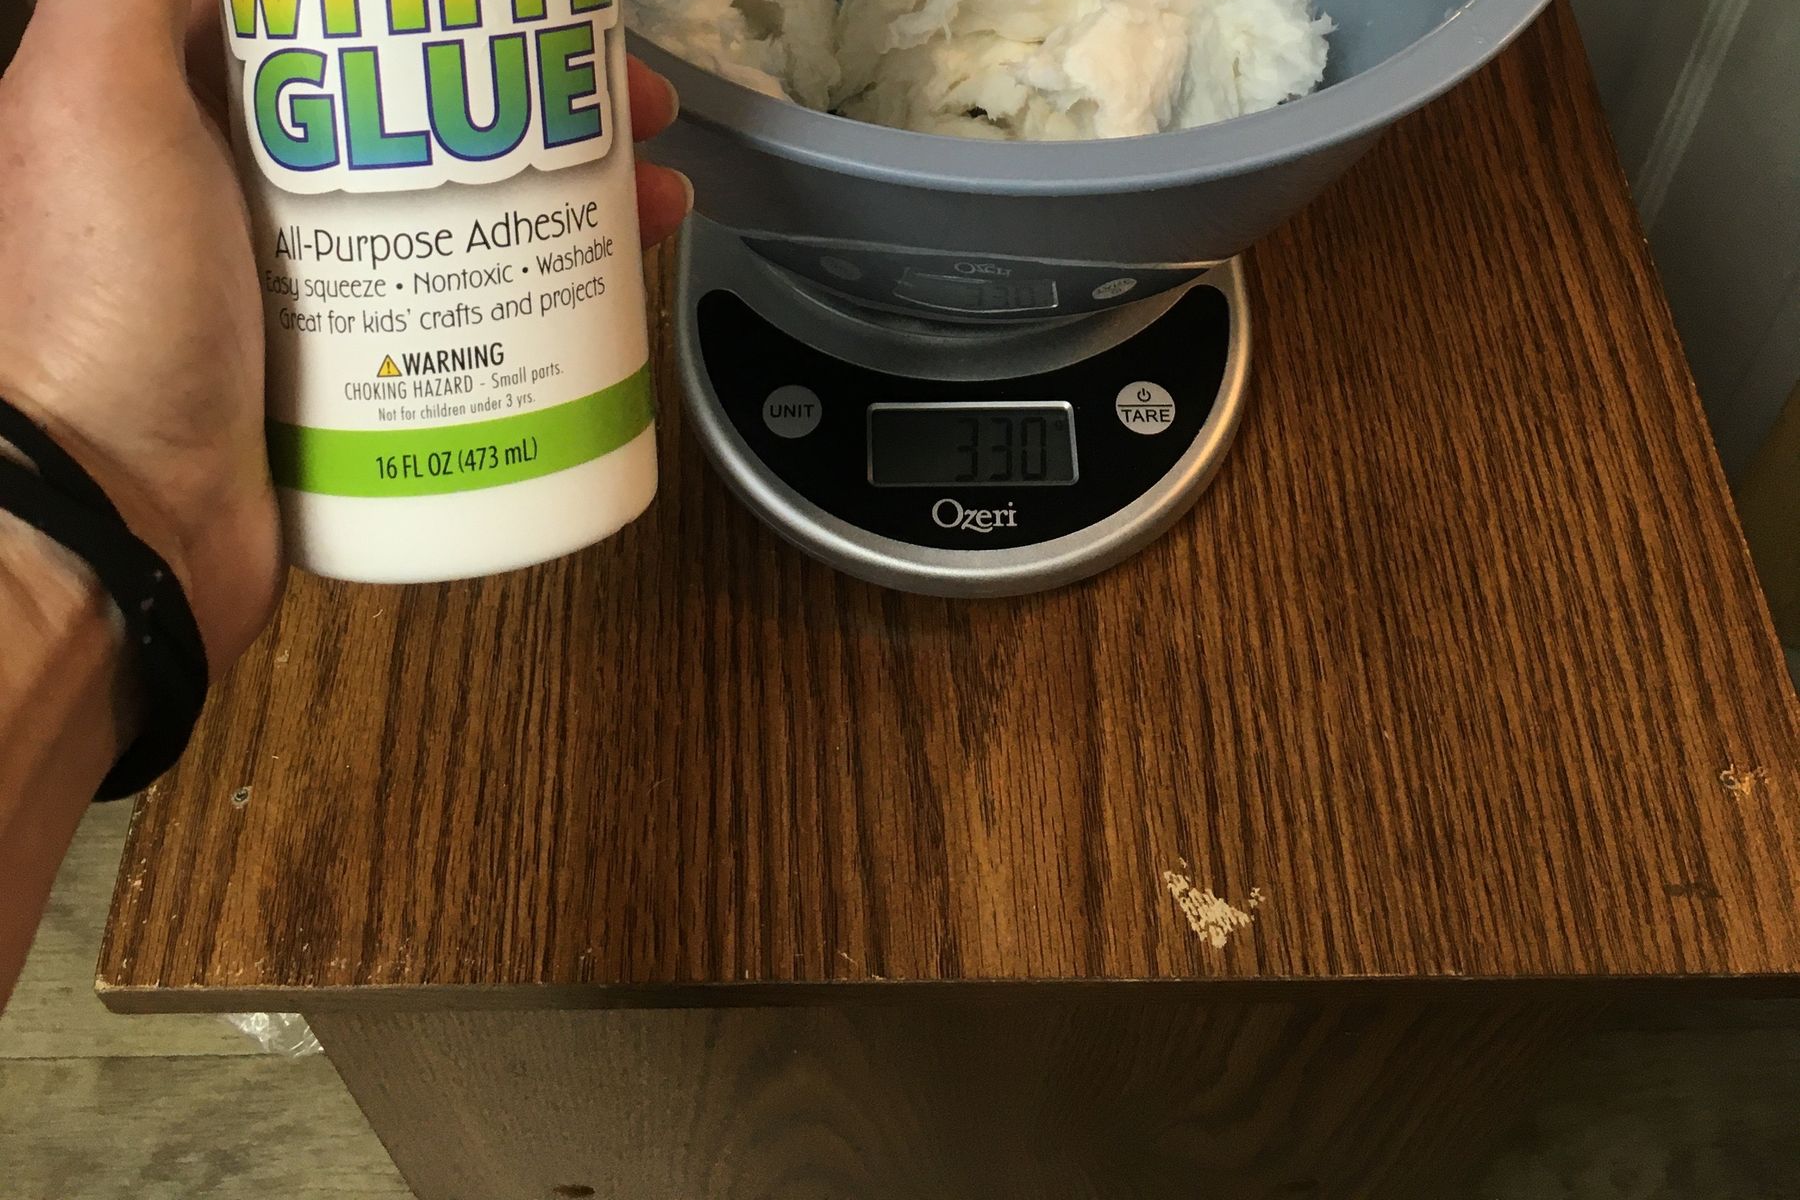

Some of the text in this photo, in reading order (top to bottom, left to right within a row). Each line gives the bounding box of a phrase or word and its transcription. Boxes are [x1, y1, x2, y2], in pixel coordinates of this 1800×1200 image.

[254, 20, 603, 173] GLUE
[275, 200, 598, 269] All-Purpose Adhesive
[265, 235, 614, 303] Easy squeeze Nontoxic Washable
[279, 307, 322, 333] Great
[328, 310, 355, 334] for
[420, 302, 484, 330] crafts
[491, 291, 533, 321] and
[540, 275, 607, 318] projects
[402, 342, 505, 377] WARNING
[344, 381, 407, 401] CHOKING
[413, 375, 473, 399] HAZARD
[492, 365, 527, 390] Small
[378, 407, 397, 422] Not
[400, 405, 416, 421] for
[420, 400, 466, 420] children
[470, 396, 502, 414] under
[506, 394, 513, 407] 3
[769, 402, 815, 420] UNIT
[1121, 407, 1171, 424] TARE
[376, 456, 398, 480] 16
[403, 454, 423, 479] FL
[428, 452, 453, 477] OZ
[458, 444, 499, 473] (473
[955, 416, 1047, 483] 330
[931, 498, 1018, 534] Ozeri
